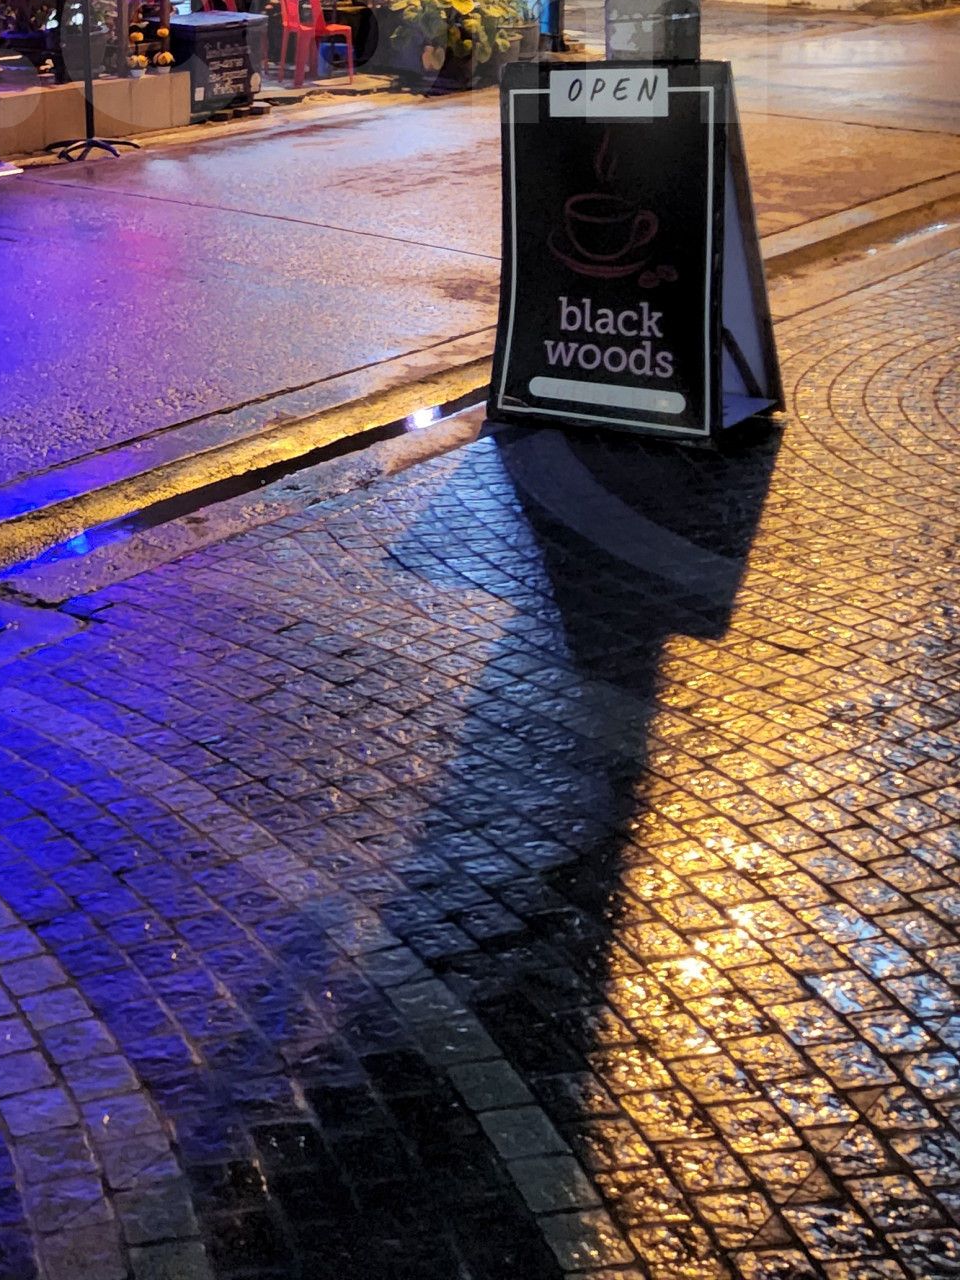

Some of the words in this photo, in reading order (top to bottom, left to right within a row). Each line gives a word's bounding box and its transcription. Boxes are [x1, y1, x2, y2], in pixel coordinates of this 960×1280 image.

[568, 75, 659, 102] OPEN
[558, 296, 664, 338] black
[544, 339, 674, 379] woods
